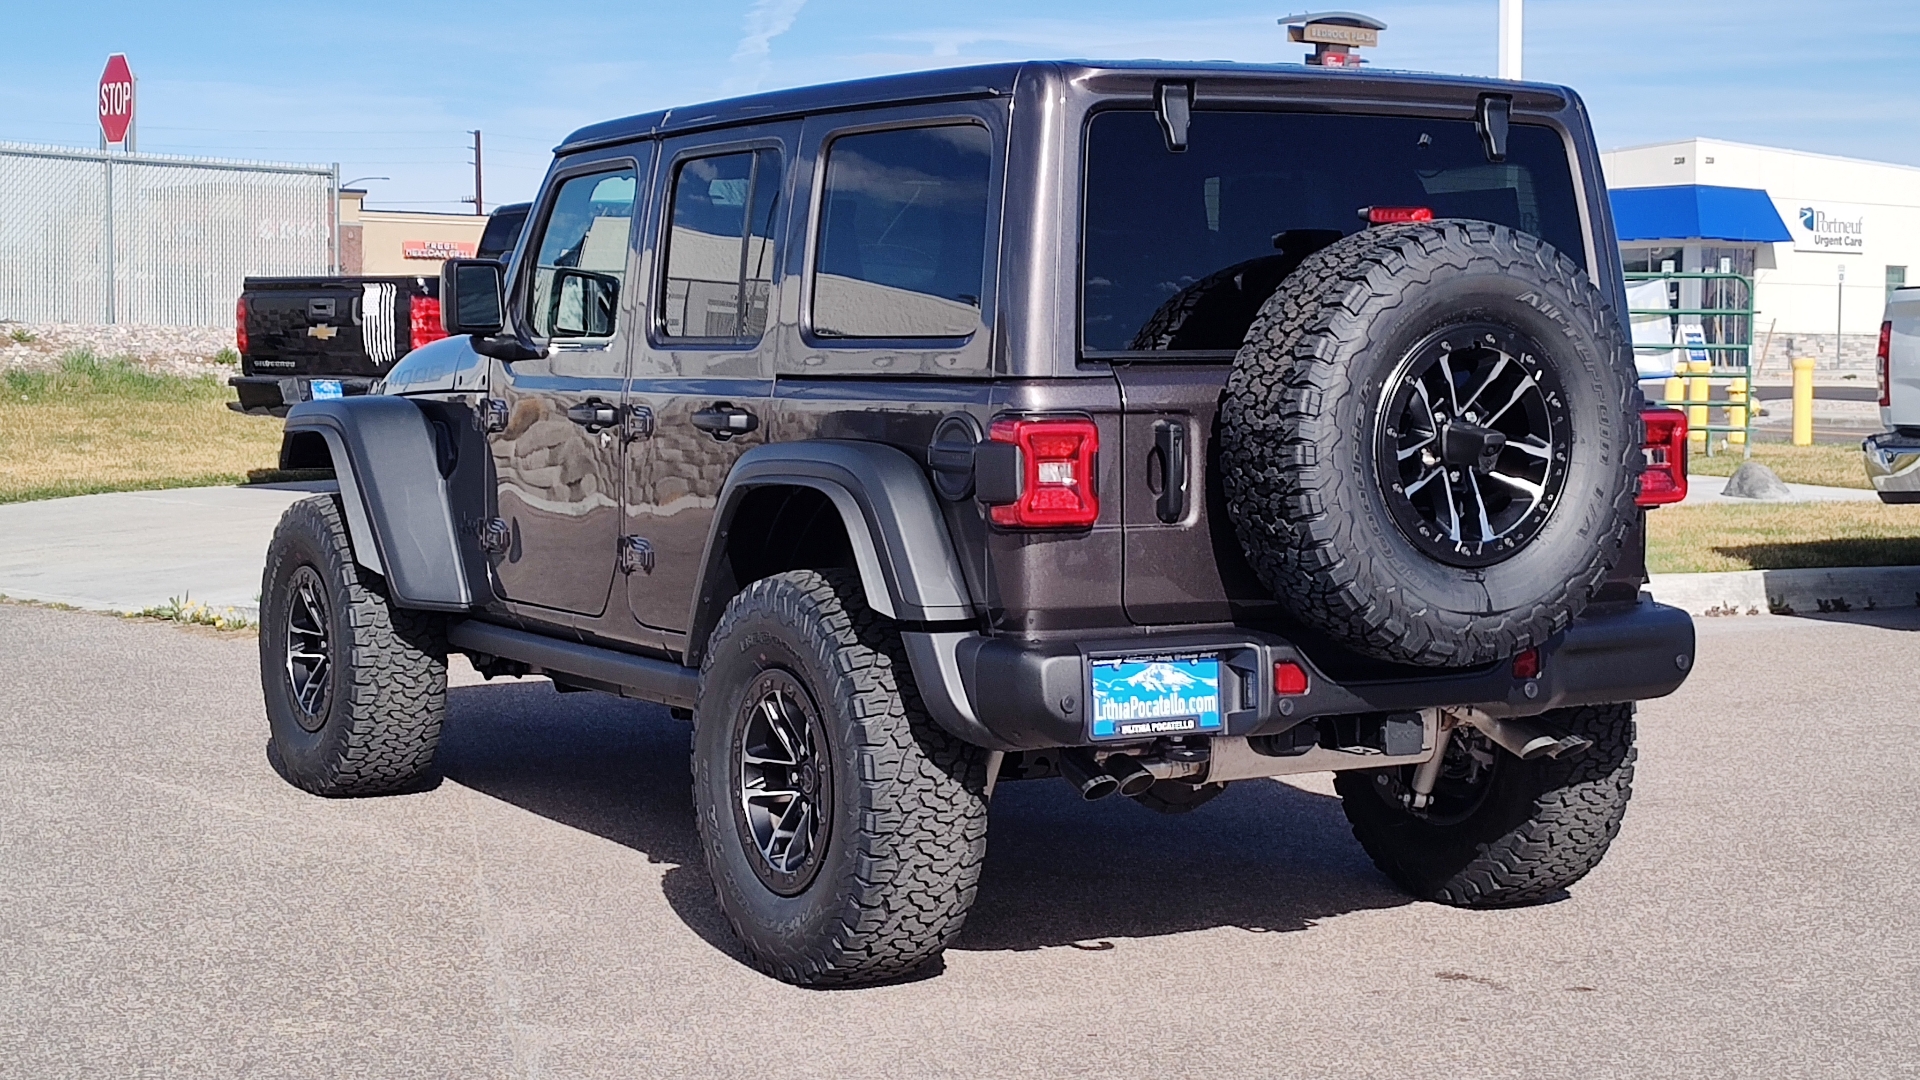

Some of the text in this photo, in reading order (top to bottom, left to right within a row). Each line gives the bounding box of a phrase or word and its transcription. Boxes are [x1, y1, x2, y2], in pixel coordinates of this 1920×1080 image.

[1311, 27, 1349, 40] BEDROCK
[100, 81, 131, 116] STOP
[1815, 210, 1863, 235] Portneuf
[1814, 234, 1863, 247] Urgent Care
[1095, 692, 1217, 721] LithiaPocatello.com
[1151, 720, 1195, 732] POCATELLO
